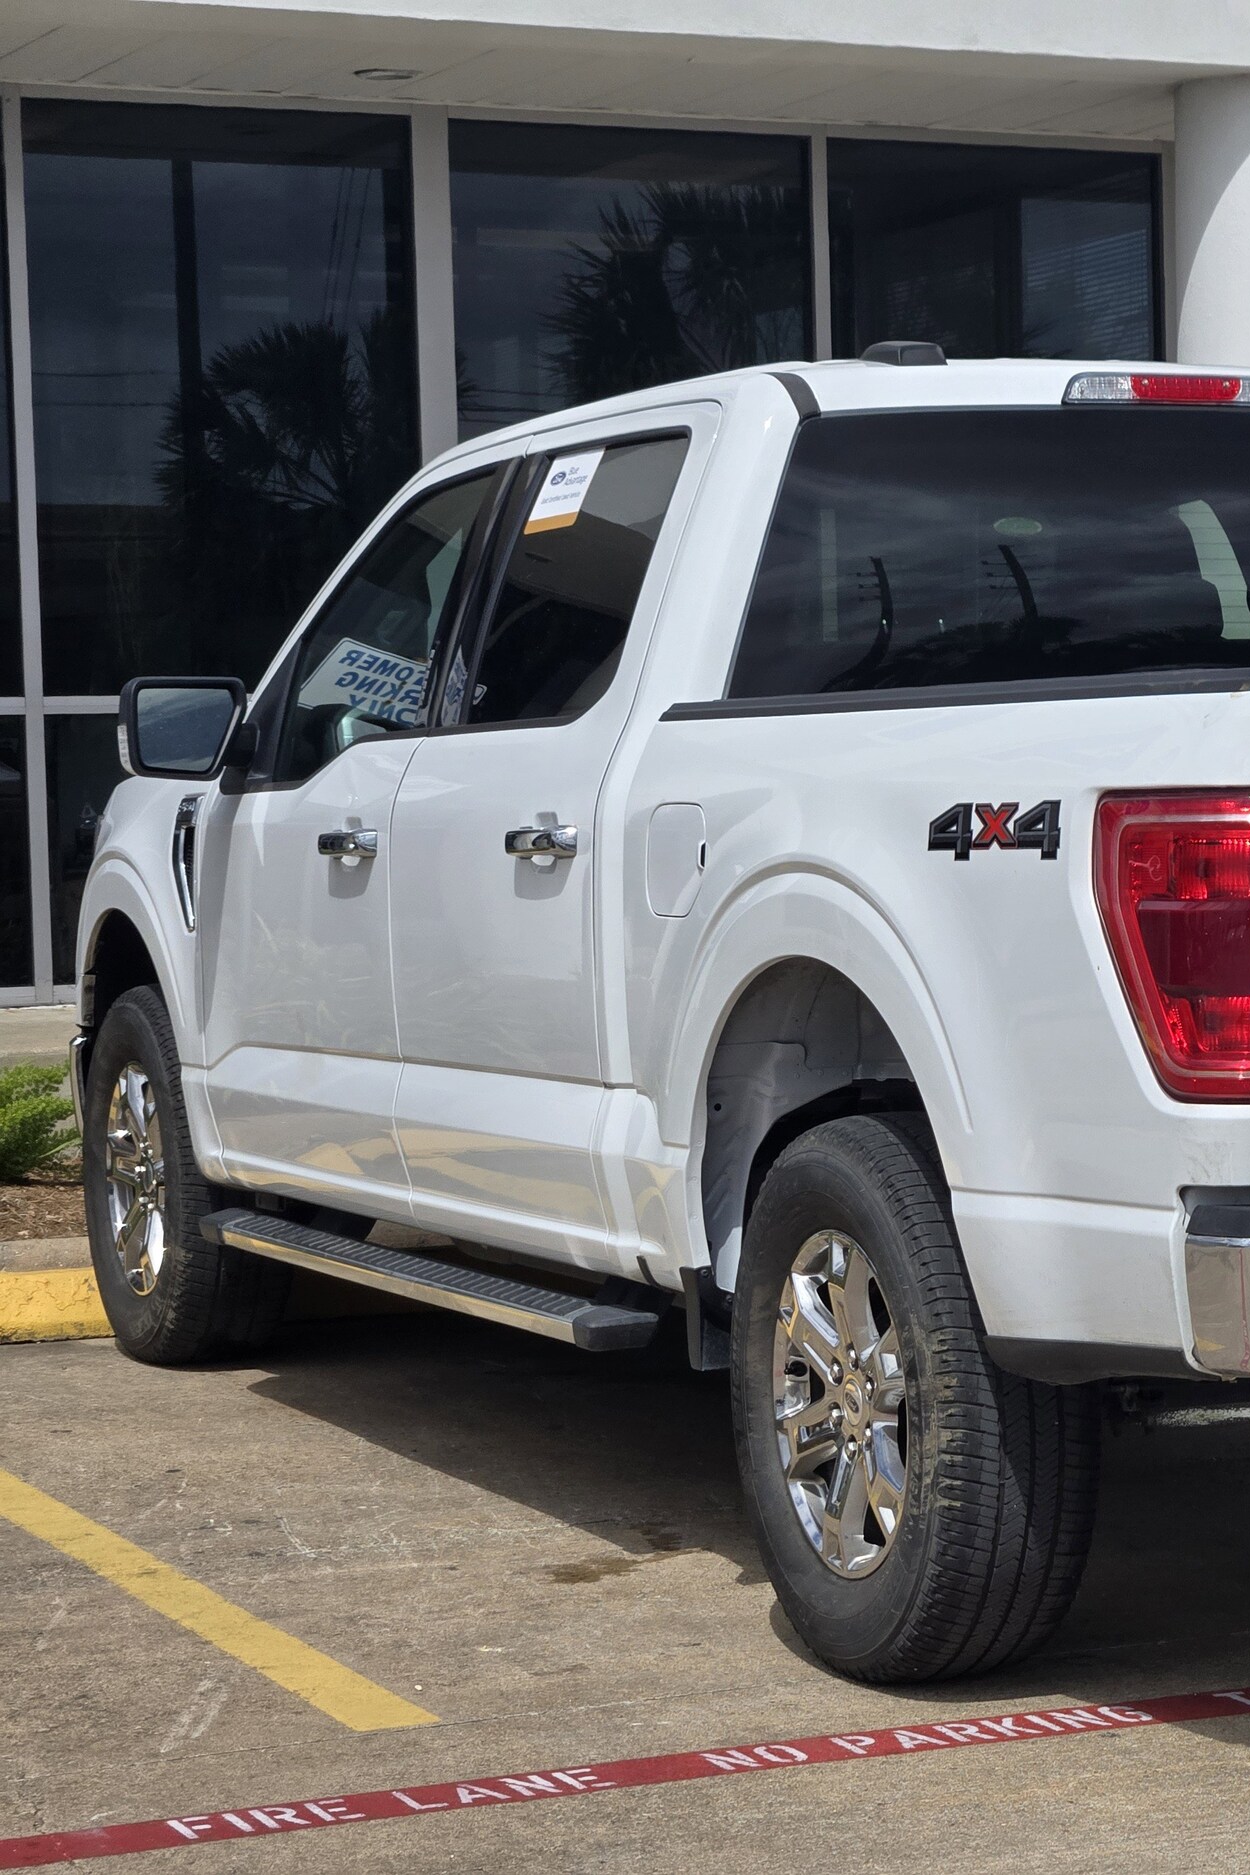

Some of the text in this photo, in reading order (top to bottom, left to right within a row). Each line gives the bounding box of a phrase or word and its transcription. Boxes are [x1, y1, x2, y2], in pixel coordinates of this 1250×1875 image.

[167, 1798, 366, 1840] FIRE
[391, 1768, 617, 1811] LANE
[699, 1744, 808, 1771] NO
[831, 1705, 1154, 1755] PARKING
